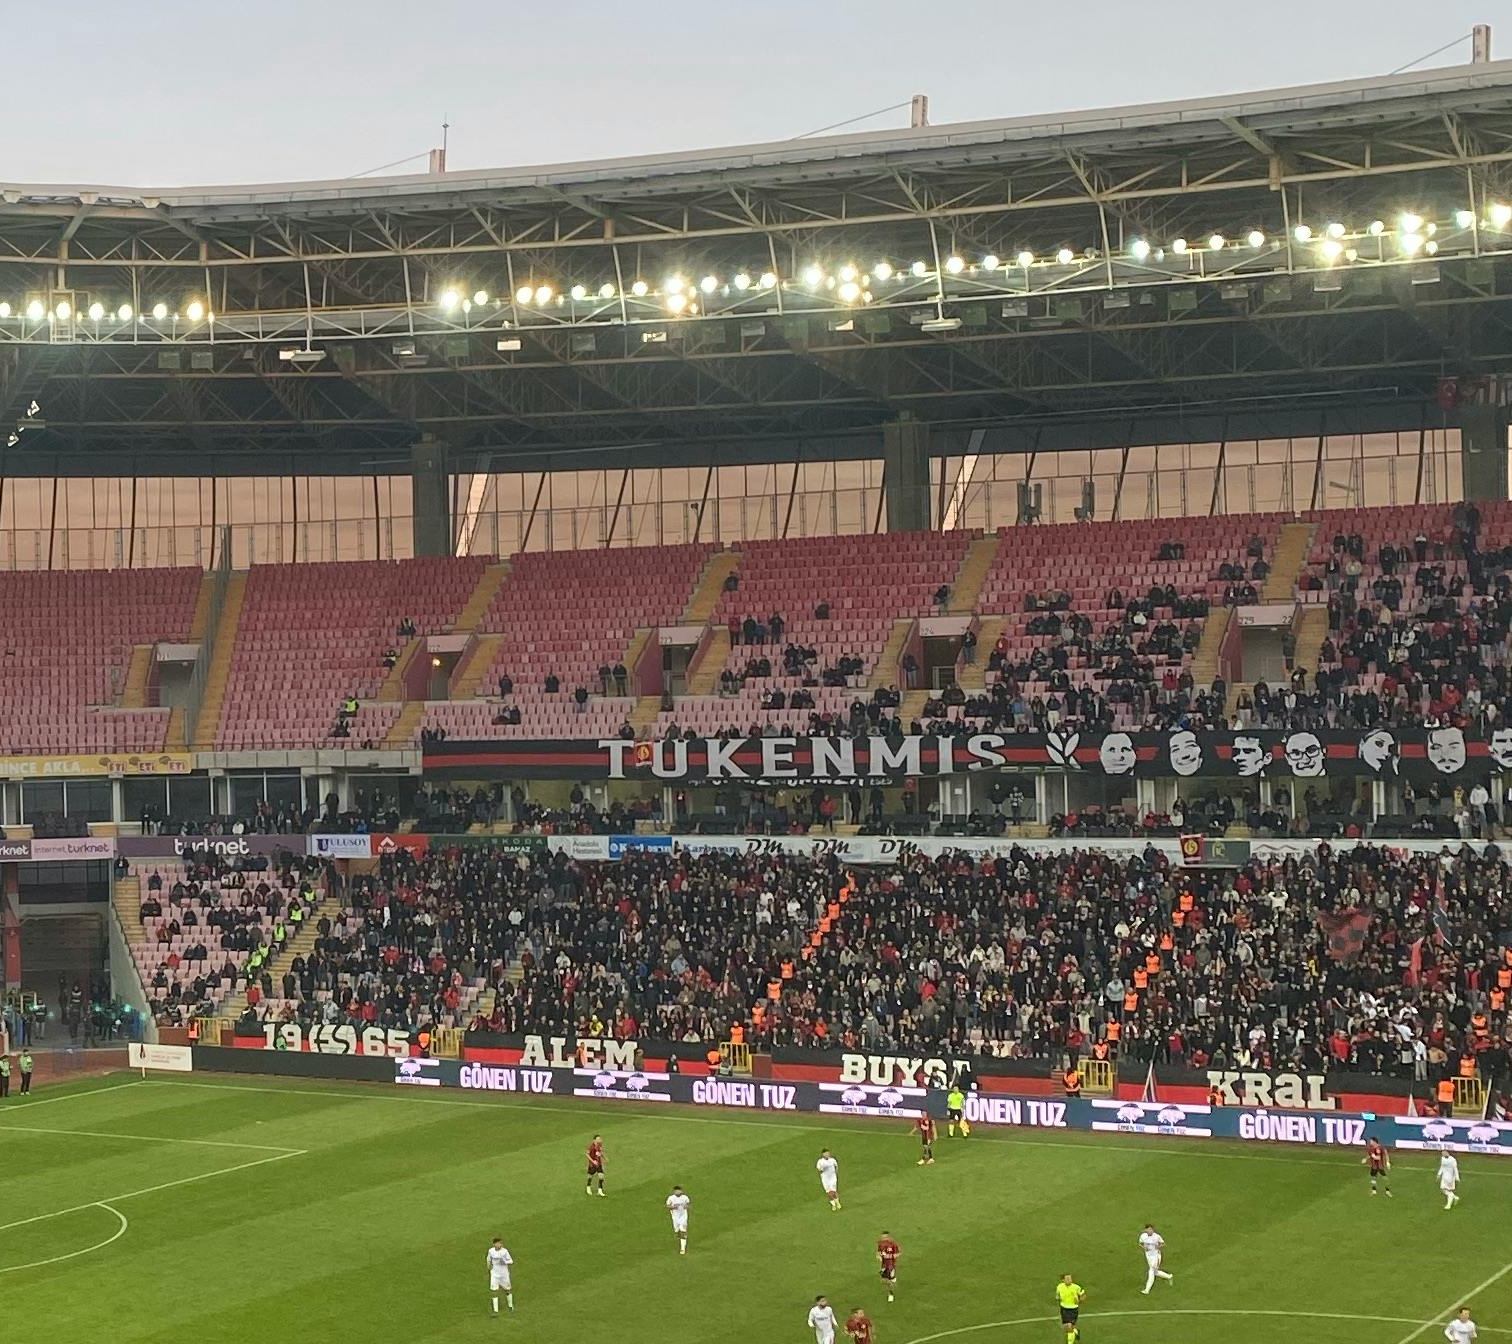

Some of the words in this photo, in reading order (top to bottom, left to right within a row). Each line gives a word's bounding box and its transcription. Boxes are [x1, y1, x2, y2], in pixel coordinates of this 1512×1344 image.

[68, 841, 110, 854] turknet
[263, 1023, 302, 1051] 19
[363, 1026, 411, 1057] 65
[520, 1034, 638, 1072] ALEM
[460, 1063, 516, 1091] GÖNEN
[520, 1069, 553, 1093] TUZ
[692, 1076, 755, 1107] GÖNEN
[760, 1084, 797, 1109] TUZ
[963, 1092, 1021, 1125] ÖNEN
[1026, 1101, 1067, 1127] TUZ
[1238, 1109, 1316, 1143] GÖNEN
[1321, 1118, 1367, 1146] TUZ
